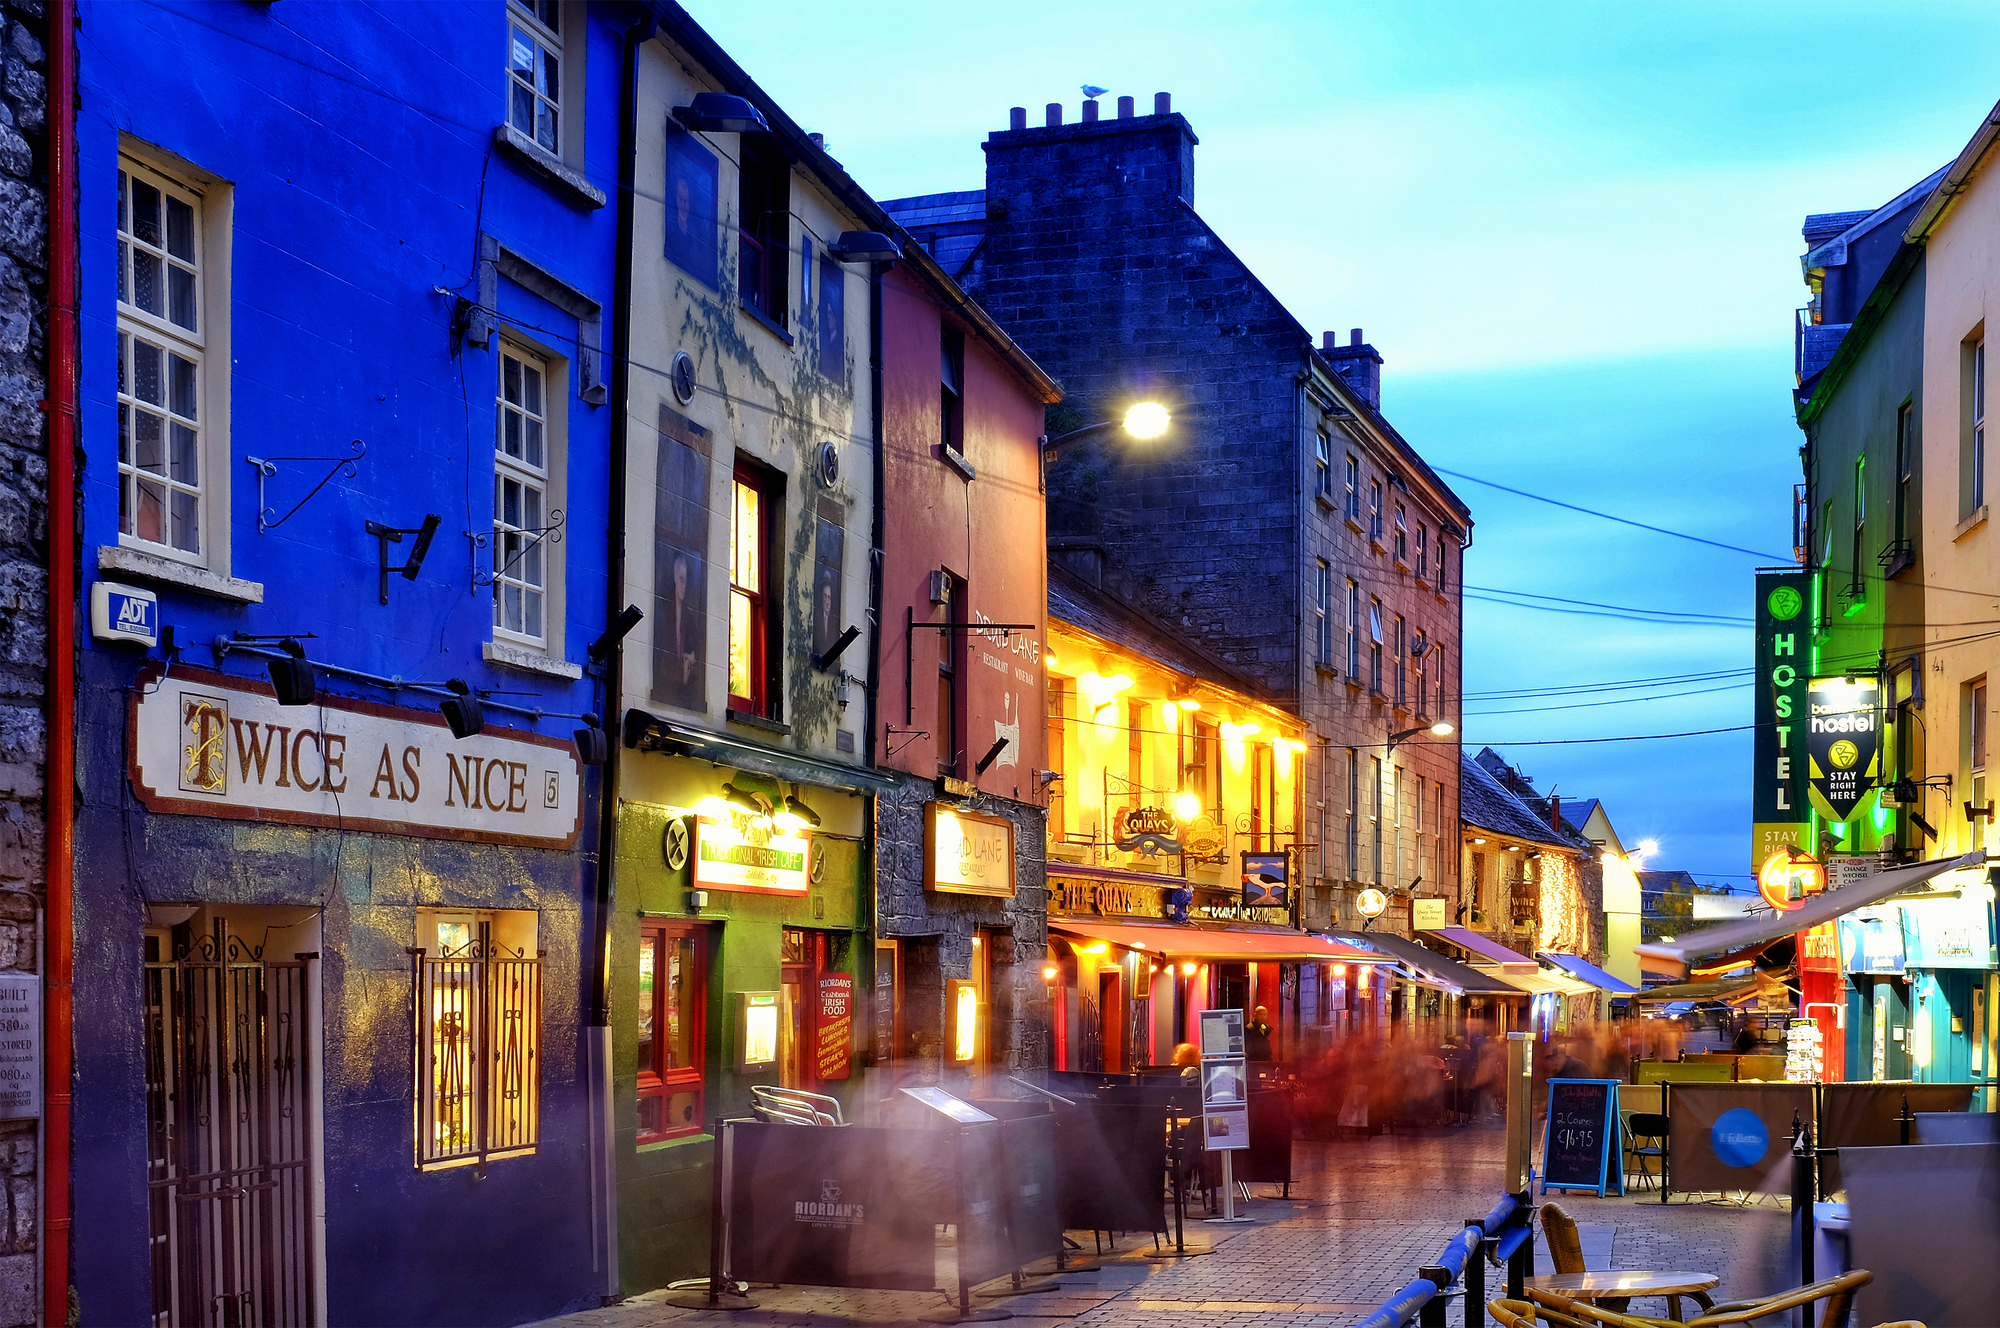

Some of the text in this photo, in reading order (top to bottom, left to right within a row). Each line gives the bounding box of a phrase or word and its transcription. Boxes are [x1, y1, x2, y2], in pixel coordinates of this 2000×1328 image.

[119, 597, 149, 625] ADT
[1010, 629, 1039, 666] LANE
[983, 651, 1009, 675] RESTAURANT
[1772, 633, 1796, 810] HOSTEL
[1811, 713, 1875, 734] hostel
[183, 699, 557, 813] TWICE AS NICE 5
[1830, 772, 1857, 781] STAY
[1830, 782, 1856, 790] RIGHT
[1830, 791, 1857, 800] HERE
[1141, 811, 1159, 820] THE
[1130, 819, 1168, 832] QUAYS
[1764, 831, 1798, 842] STAY
[974, 838, 1002, 863] LANE
[1063, 883, 1134, 917] THE QUAYS
[1511, 897, 1535, 906] WINE
[1512, 906, 1534, 916] BAR
[825, 998, 845, 1006] IRISH
[823, 1006, 846, 1016] FOOD
[821, 1057, 847, 1079] SALMON
[1557, 1112, 1566, 1124] 2
[795, 1201, 864, 1218] RIORDAN'S
